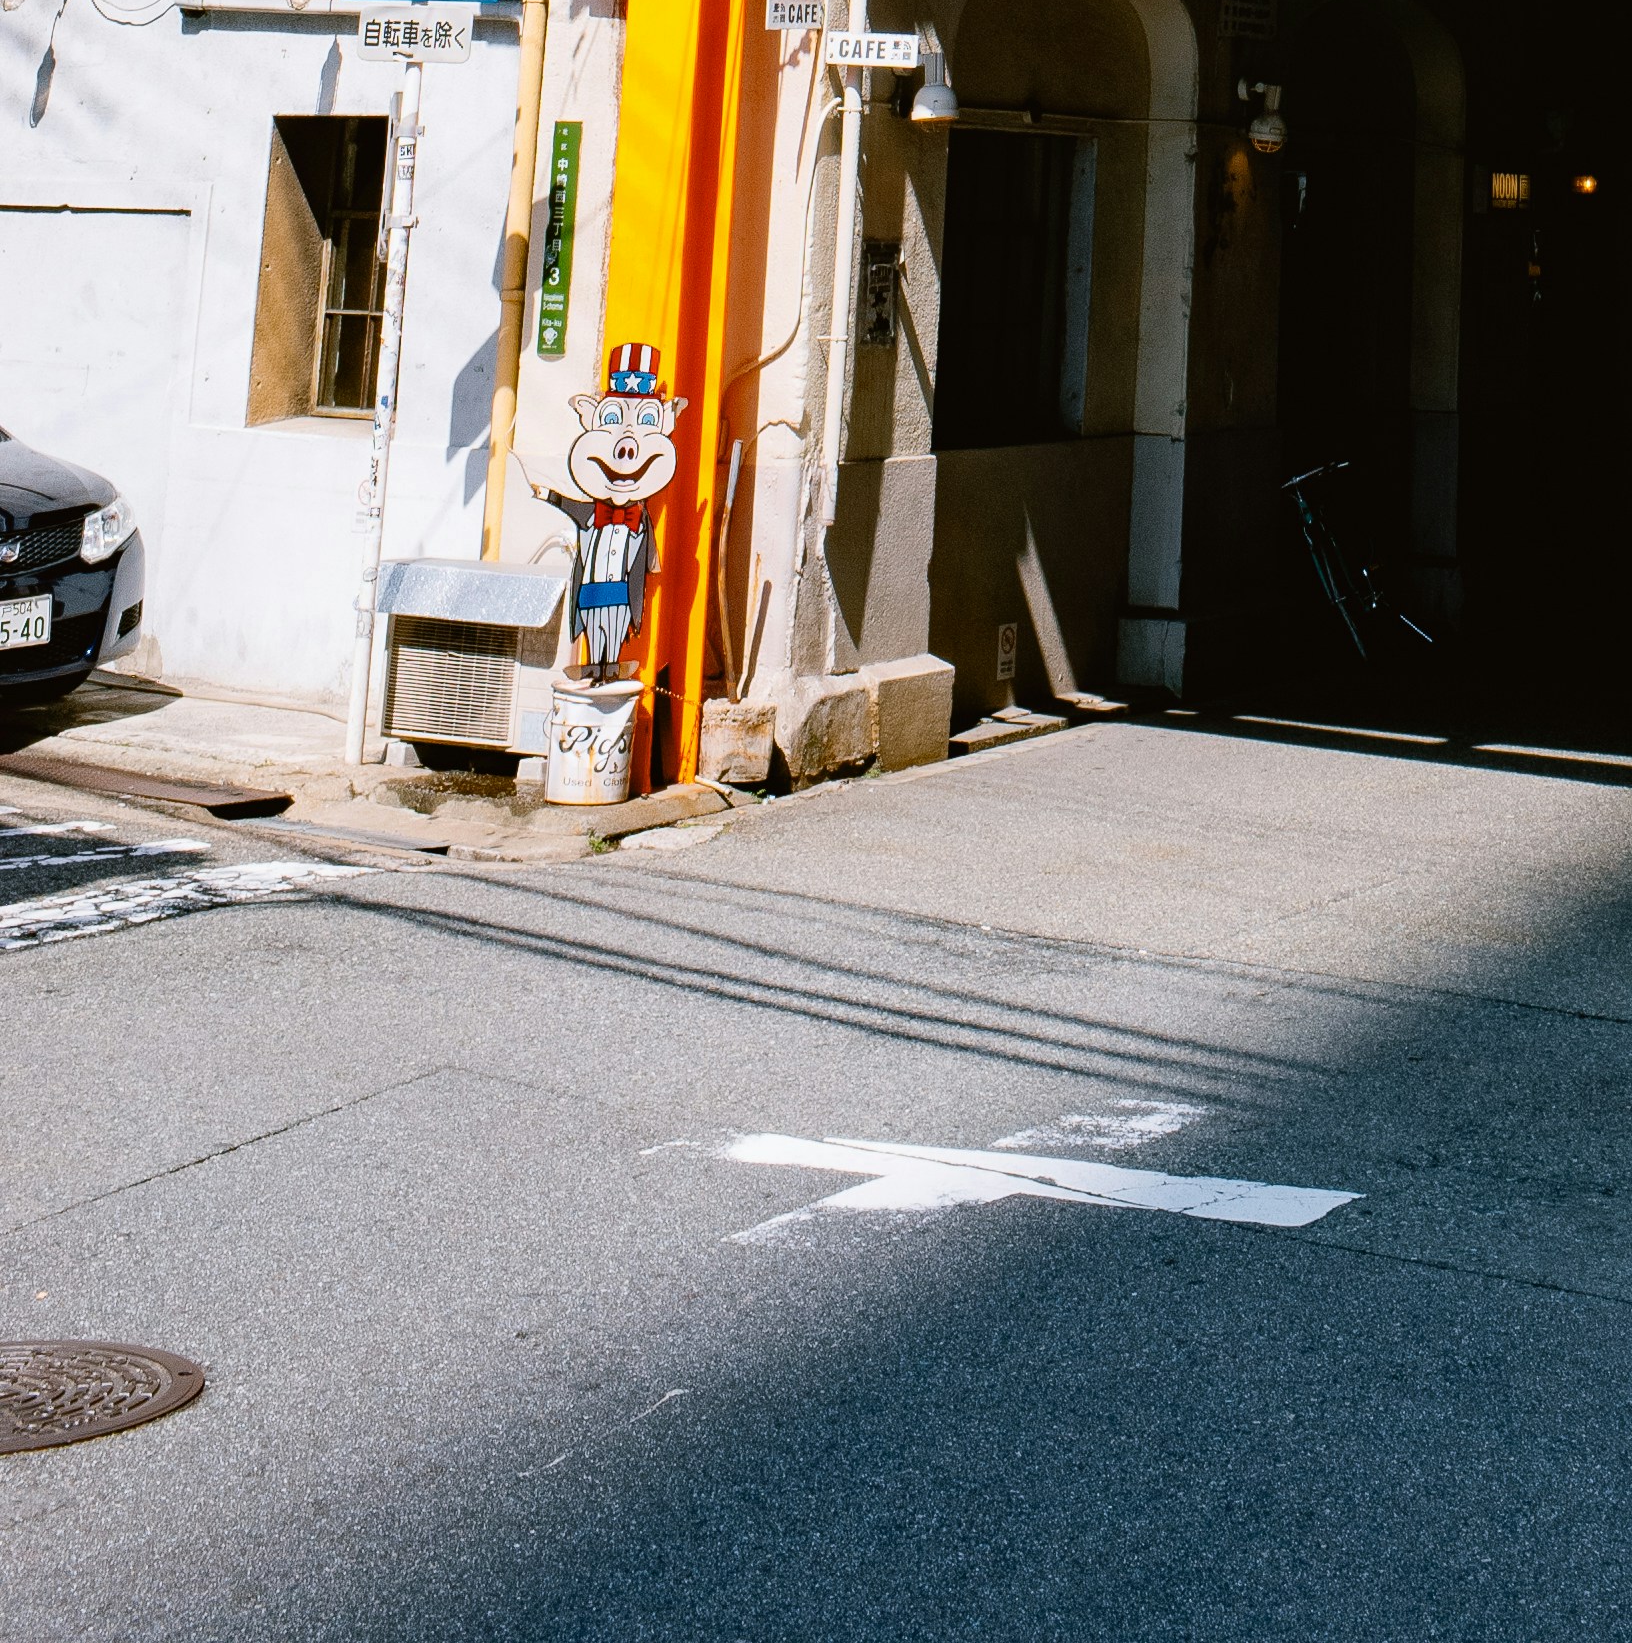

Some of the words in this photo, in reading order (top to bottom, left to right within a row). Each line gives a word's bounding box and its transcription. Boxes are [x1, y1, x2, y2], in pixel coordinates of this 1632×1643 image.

[788, 3, 818, 24] CAFE
[364, 18, 466, 49] 自転車を除く
[839, 39, 887, 60] CAFE
[1492, 172, 1518, 200] NOON
[549, 267, 560, 286] 3
[563, 776, 592, 787] Used
